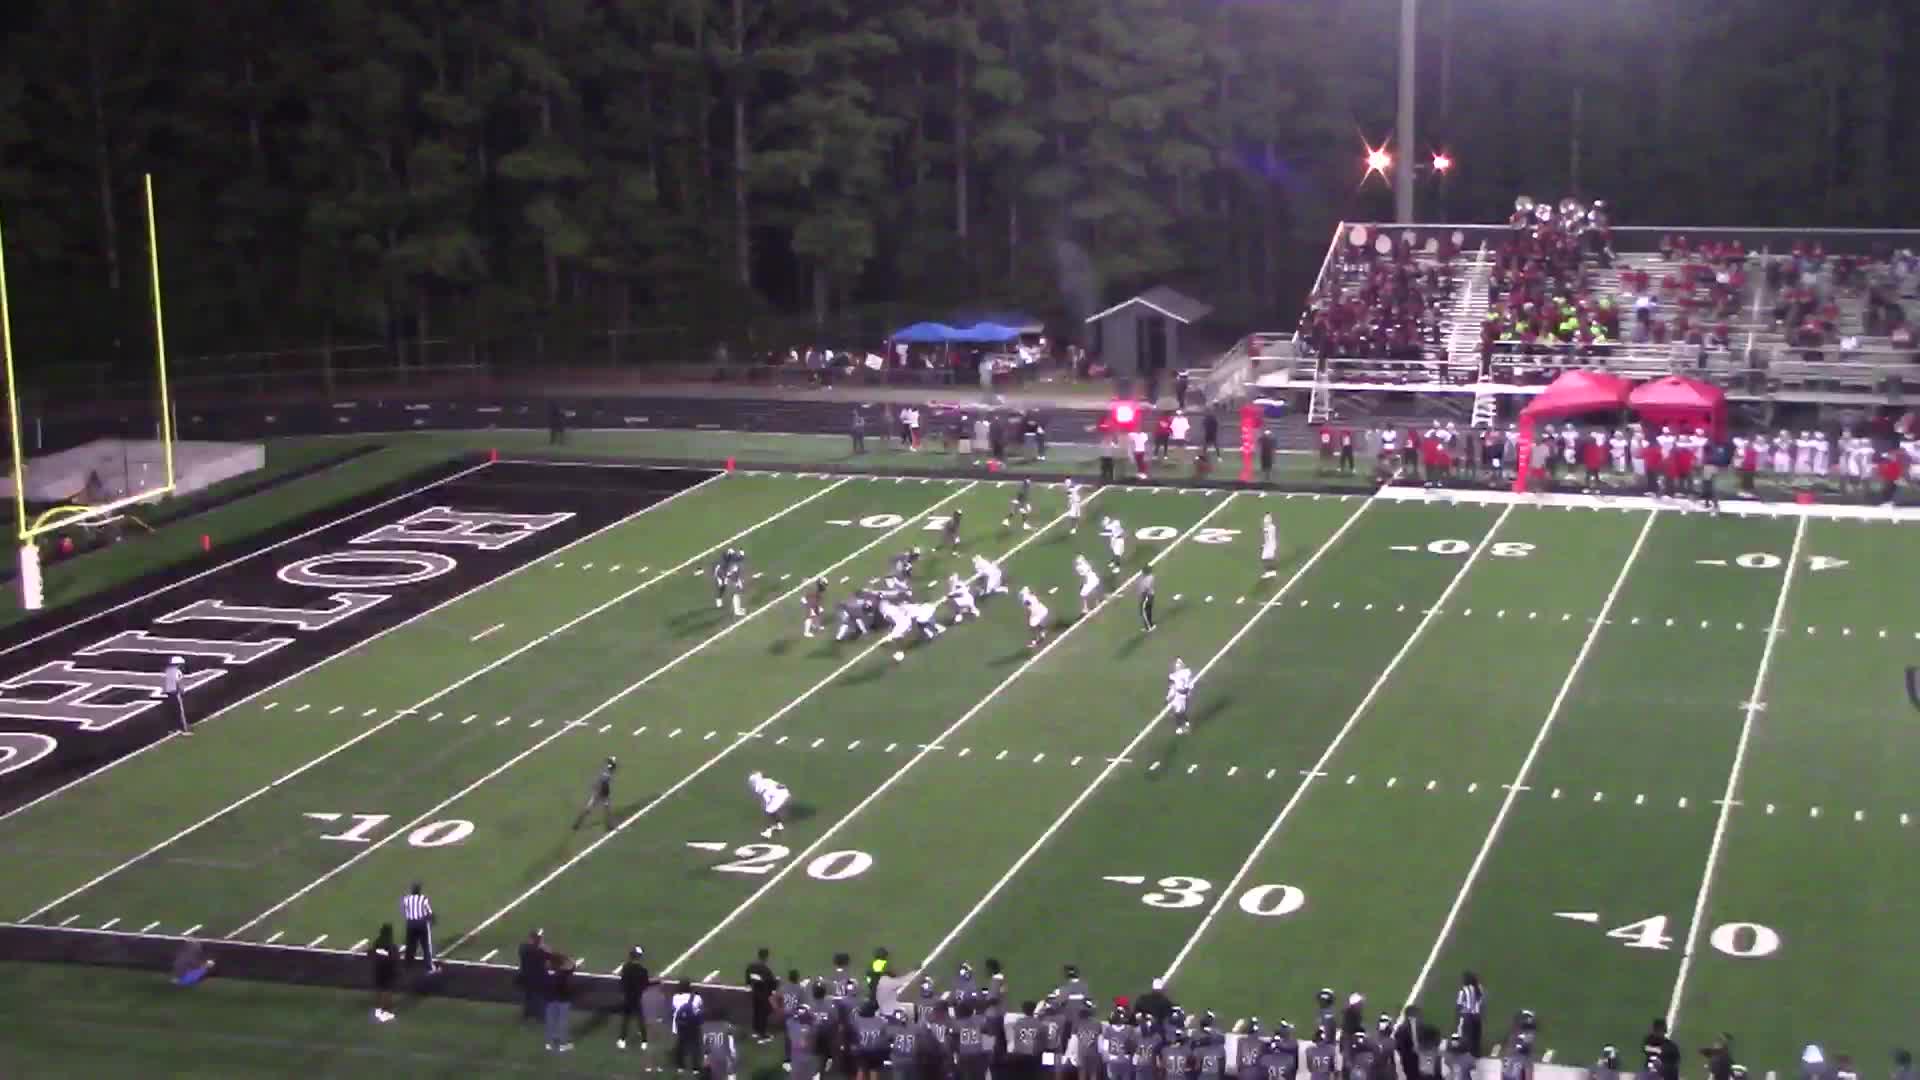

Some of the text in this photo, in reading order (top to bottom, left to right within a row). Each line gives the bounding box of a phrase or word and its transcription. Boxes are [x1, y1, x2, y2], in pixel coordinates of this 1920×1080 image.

[1427, 538, 1537, 558] 30
[1735, 552, 1849, 571] 40
[320, 814, 476, 848] 10
[711, 844, 874, 880] 20
[1141, 876, 1306, 917] 30
[1606, 914, 1781, 958] 40
